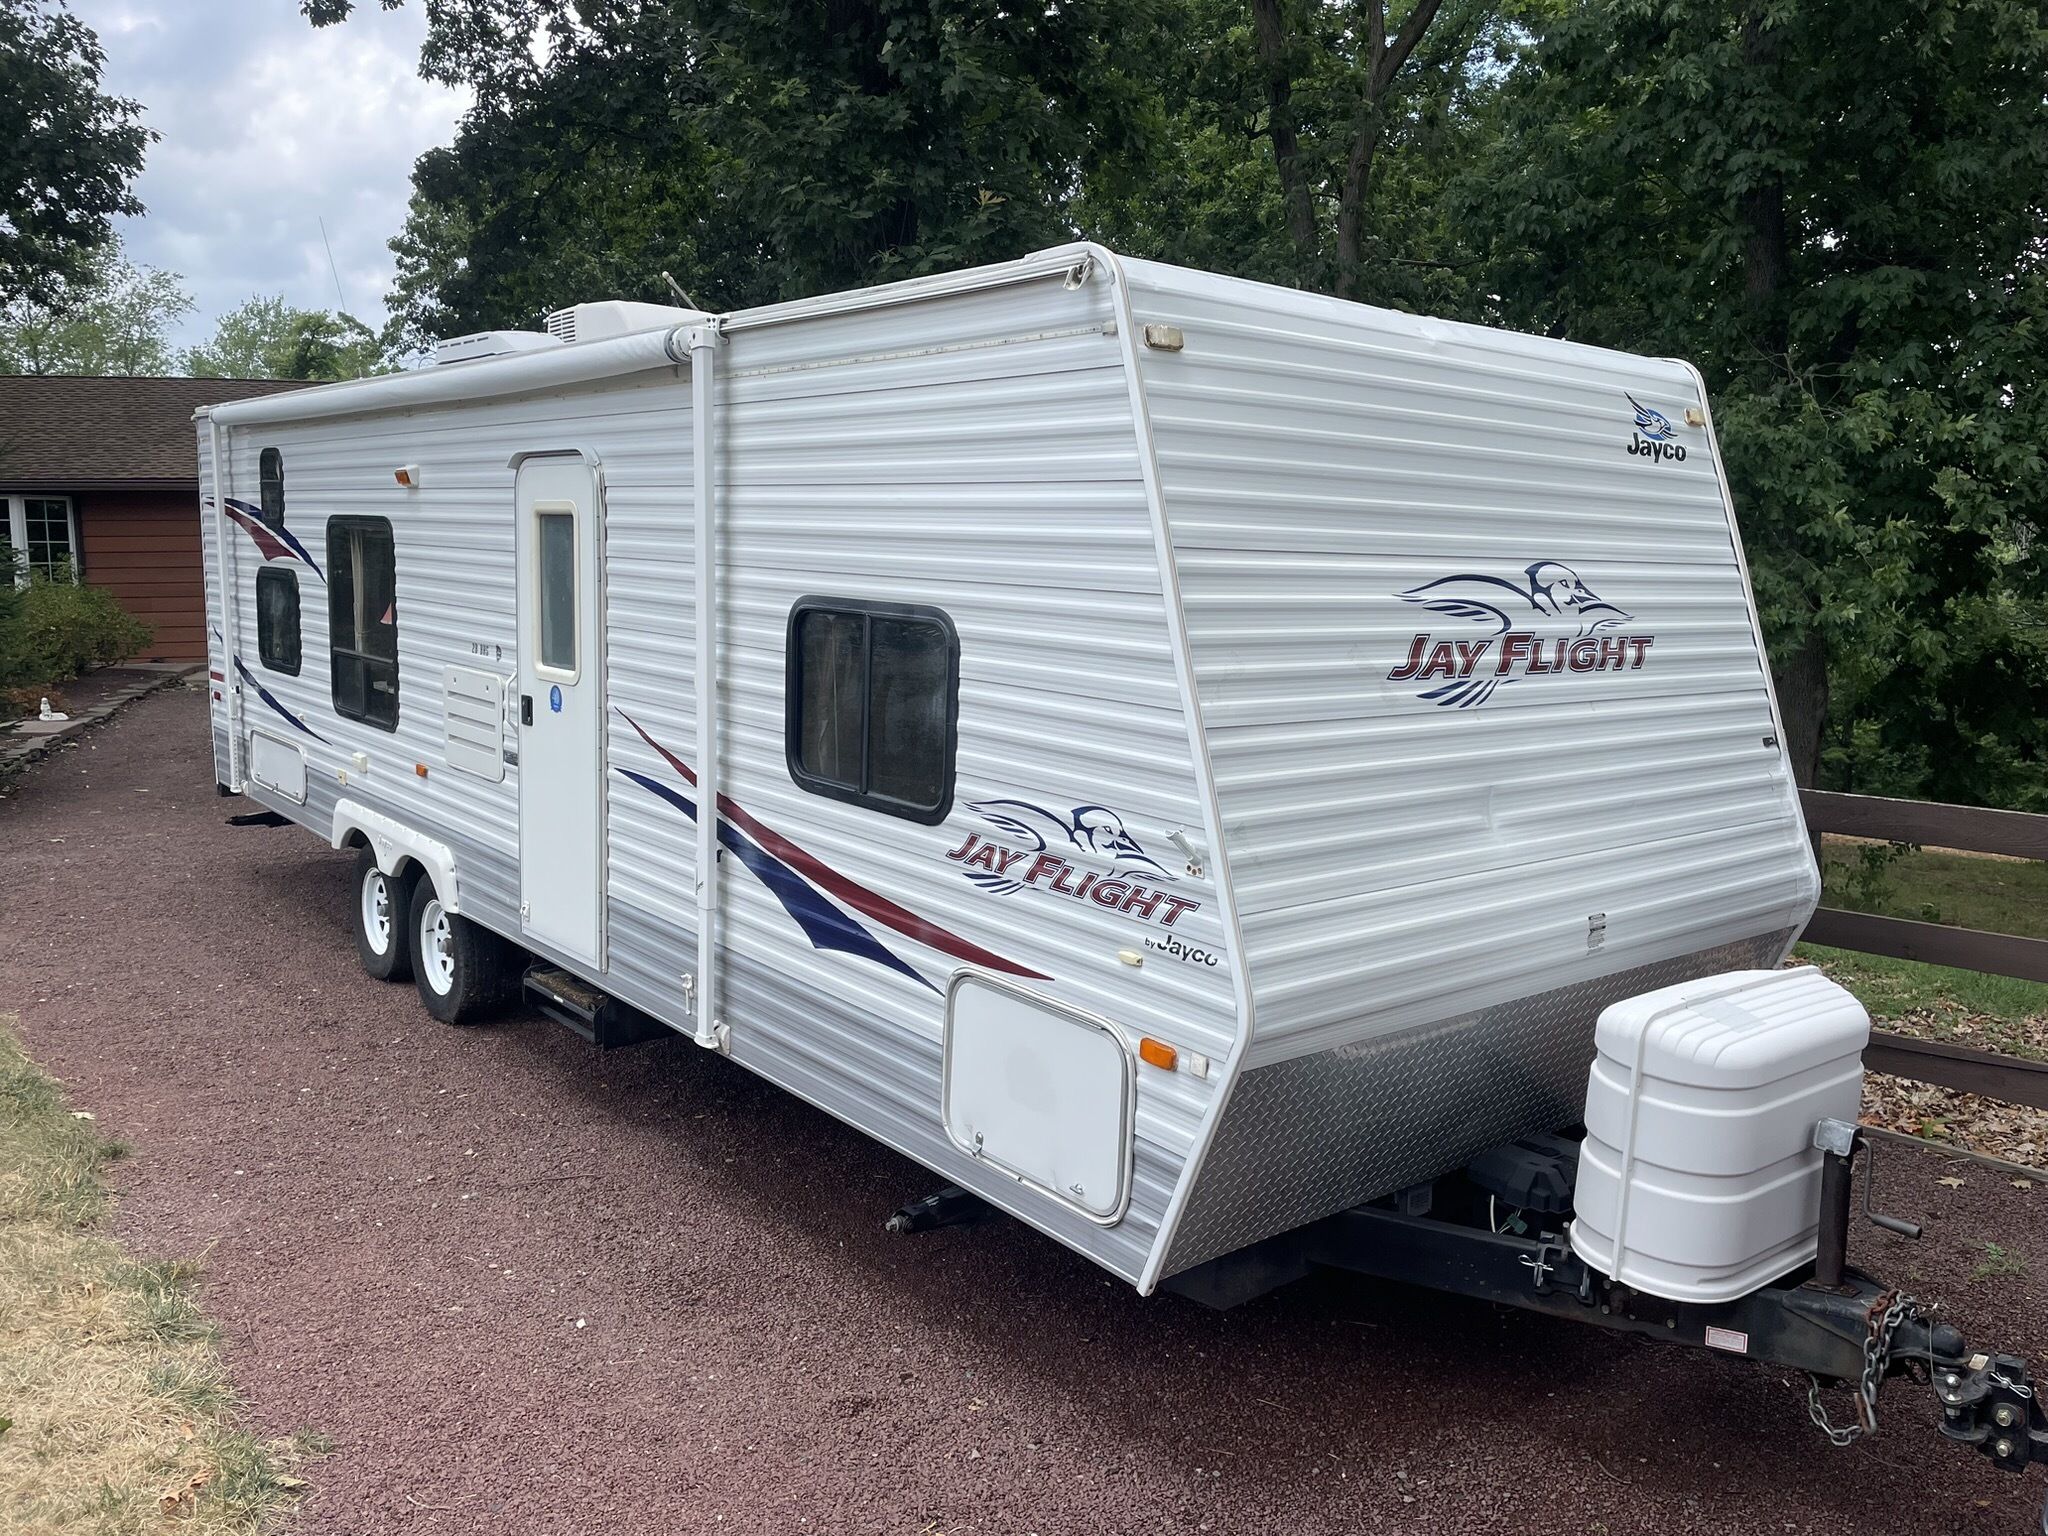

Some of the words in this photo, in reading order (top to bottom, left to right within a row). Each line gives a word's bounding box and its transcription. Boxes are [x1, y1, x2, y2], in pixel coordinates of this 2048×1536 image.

[1627, 432, 1687, 463] Jayco
[1386, 633, 1494, 681] JAY
[1494, 631, 1654, 676] FLIGHT
[945, 832, 1028, 875] JAY
[1022, 852, 1201, 926] FLIGHT
[1144, 937, 1156, 949] by
[1157, 934, 1218, 966] Jayco
